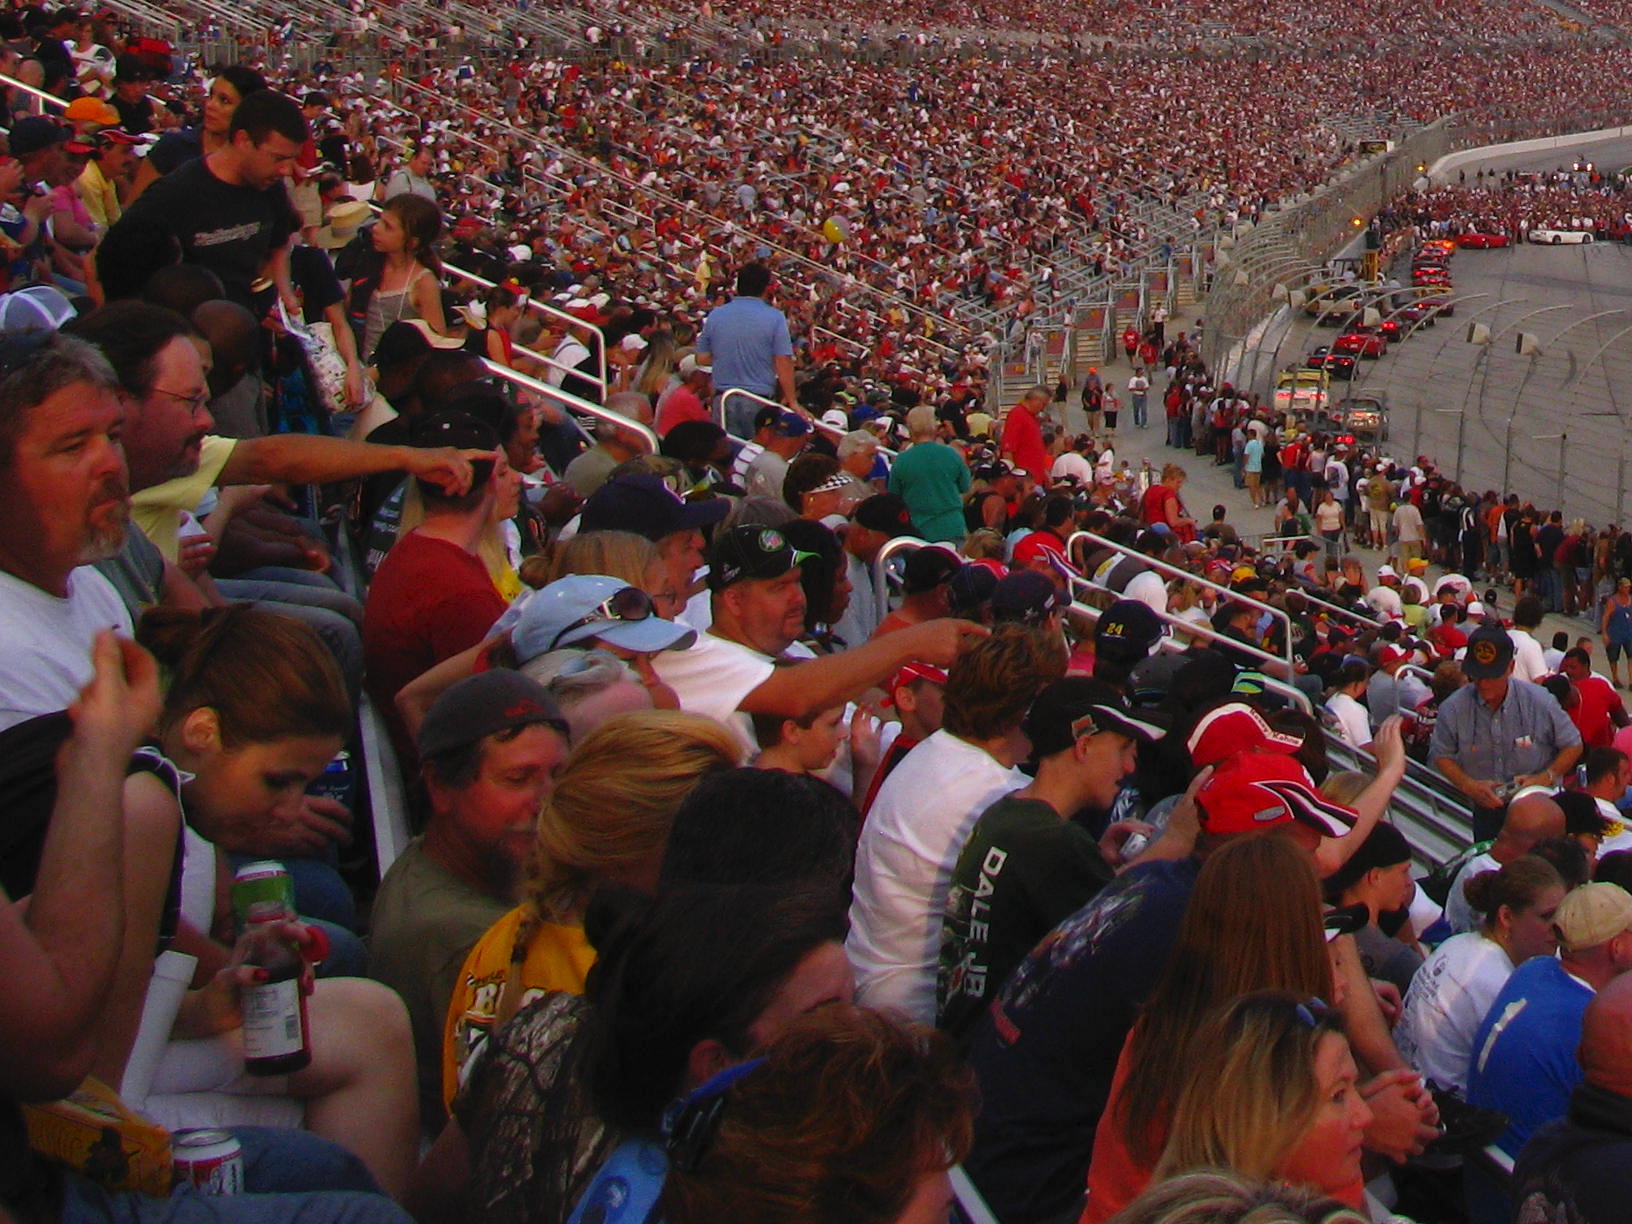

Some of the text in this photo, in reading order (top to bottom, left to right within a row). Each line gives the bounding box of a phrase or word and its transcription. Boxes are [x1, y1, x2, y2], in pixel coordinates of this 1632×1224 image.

[1107, 622, 1124, 635] 24
[964, 846, 1008, 998] DALE JR
